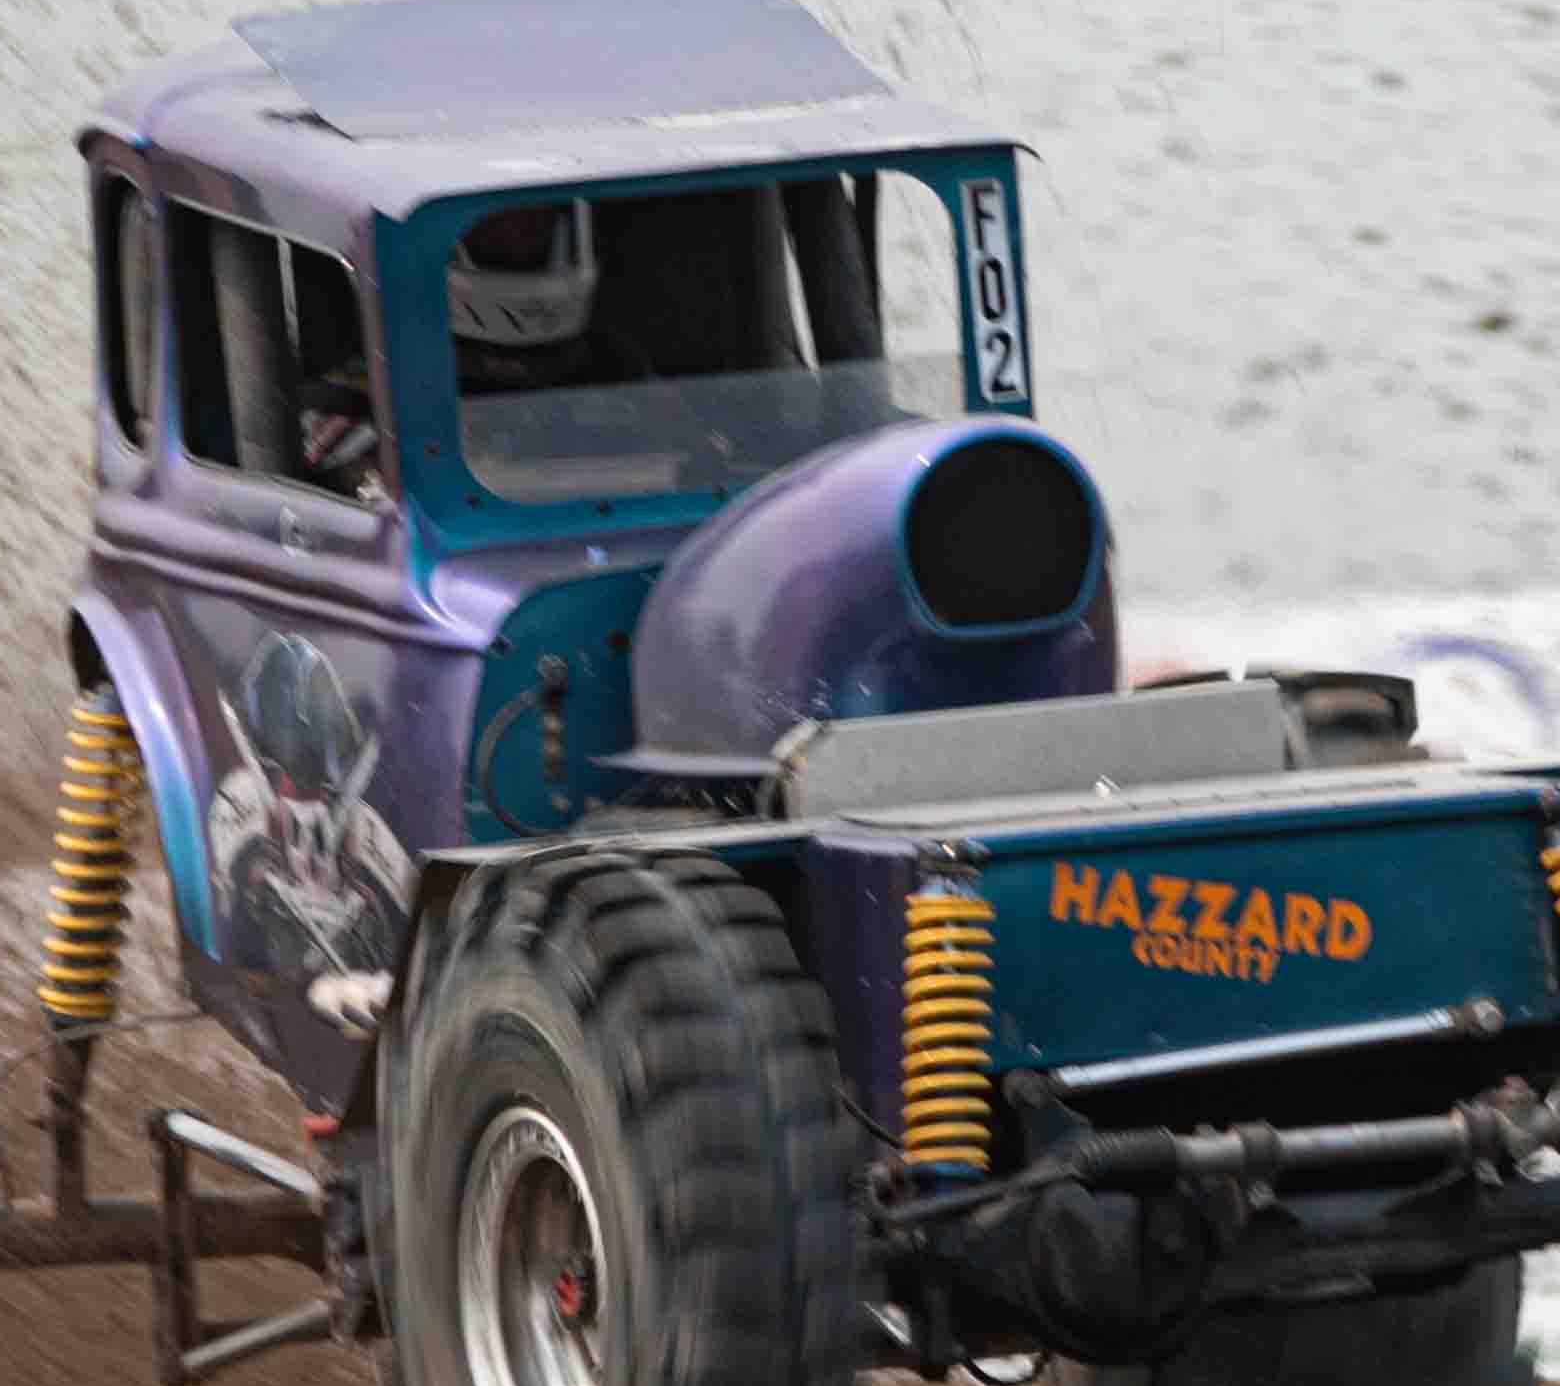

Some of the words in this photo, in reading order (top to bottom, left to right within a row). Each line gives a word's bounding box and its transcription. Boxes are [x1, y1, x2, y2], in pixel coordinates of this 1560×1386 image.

[968, 177, 1017, 393] F02
[1049, 861, 1374, 963] HAZZARD
[1131, 929, 1281, 985] COUNTY
